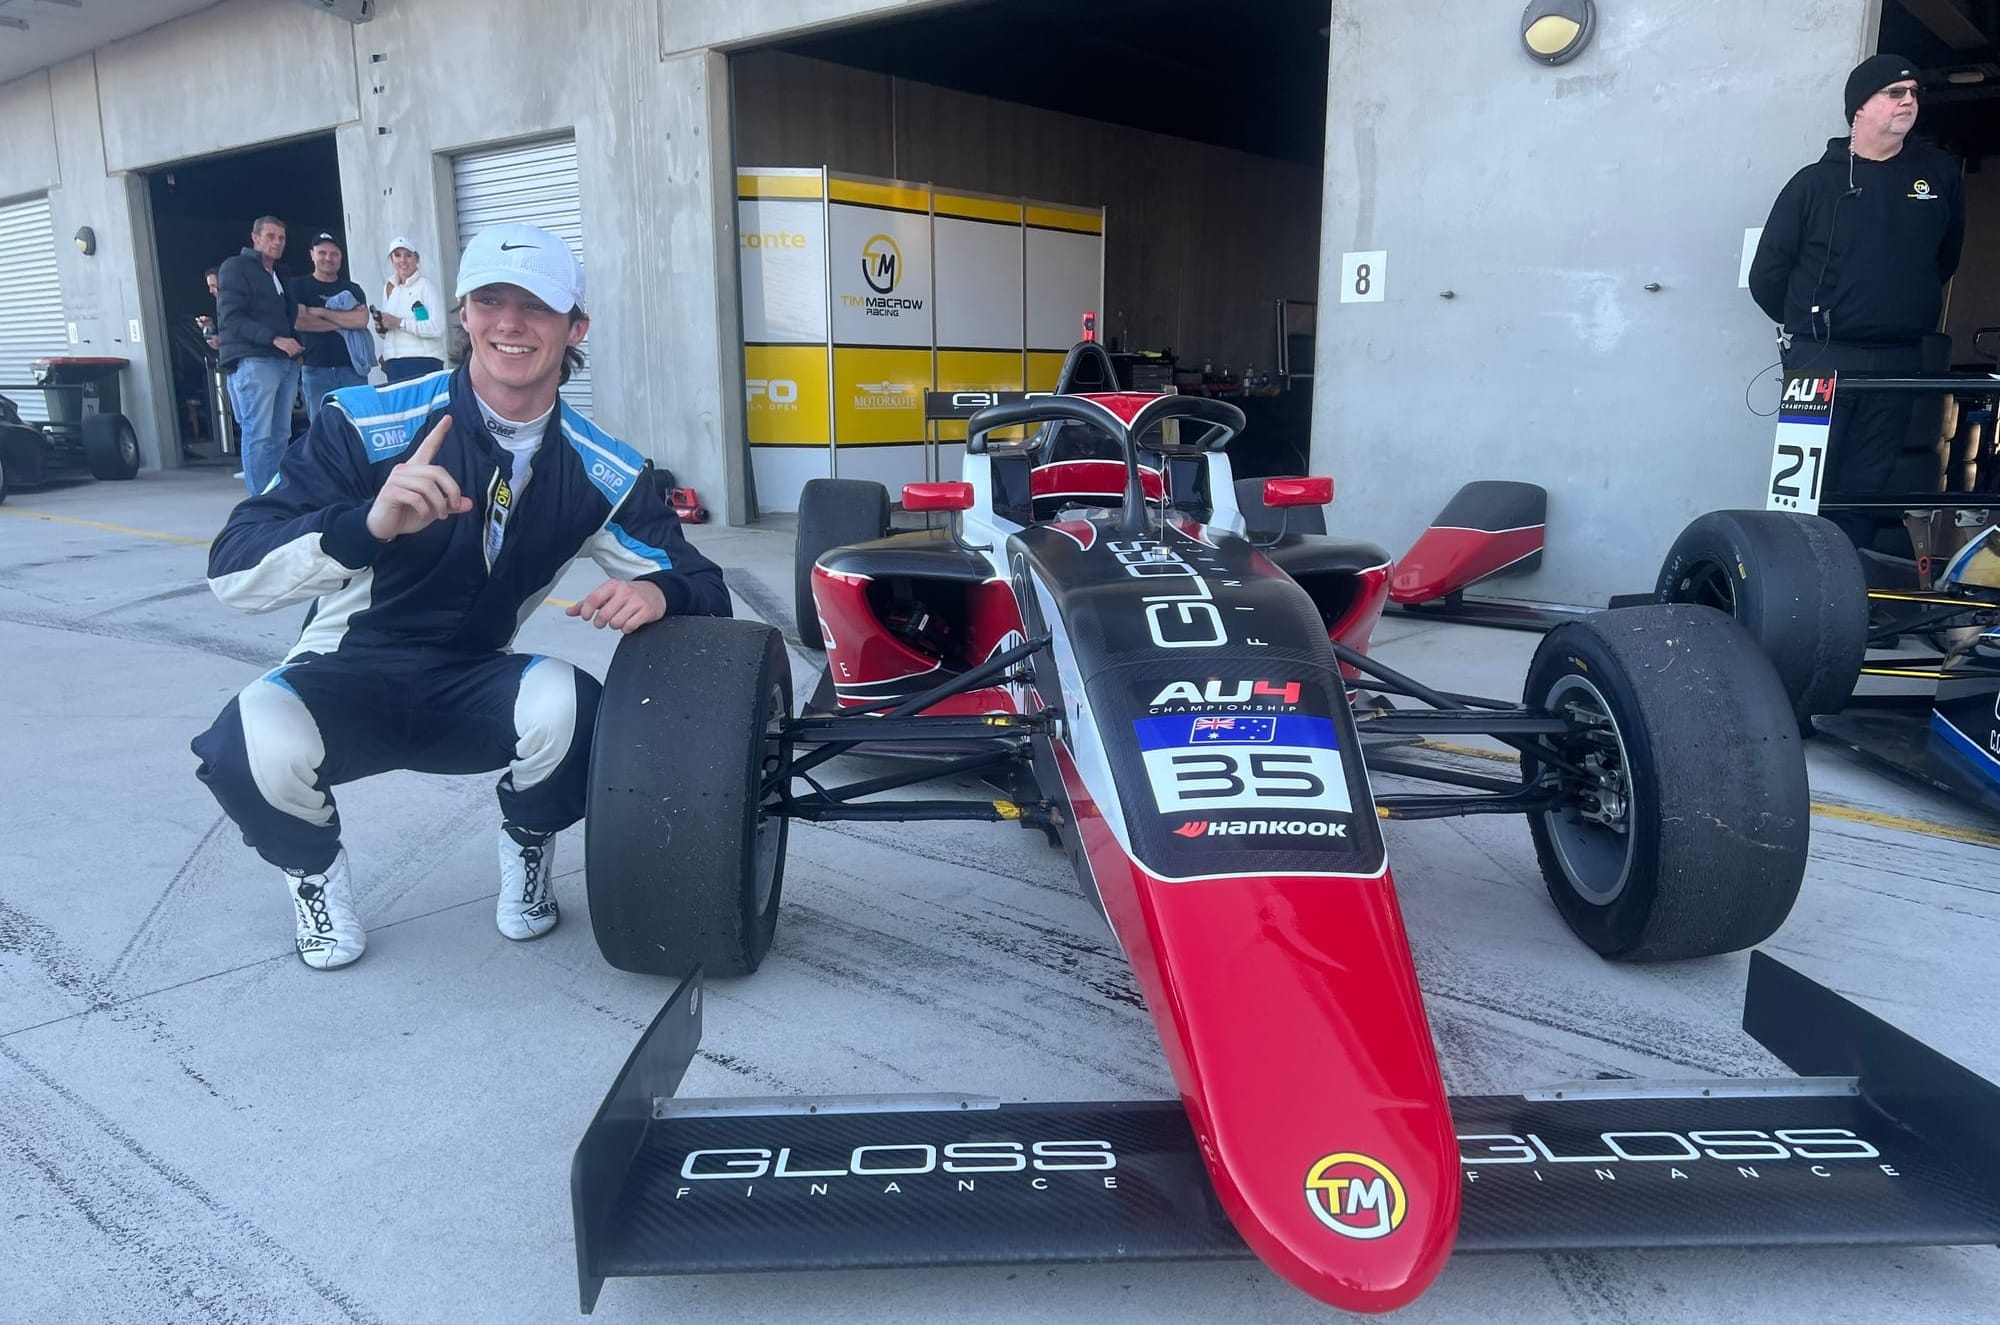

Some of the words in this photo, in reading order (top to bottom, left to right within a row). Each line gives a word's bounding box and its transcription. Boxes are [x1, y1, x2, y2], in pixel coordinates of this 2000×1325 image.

[1355, 263, 1371, 296] 8
[841, 295, 864, 307] TIM
[1783, 378, 1835, 402] AU4
[1781, 403, 1828, 411] CHAMPIONSHIP
[371, 429, 407, 448] OMP
[487, 419, 517, 436] OMP
[591, 463, 624, 488] OMP
[1771, 444, 1822, 500] 21
[1150, 680, 1301, 706] AU4
[1149, 704, 1298, 714] CHAMPIONSHIP
[1172, 753, 1325, 800] 35
[1456, 1129, 1880, 1164] GLOSS
[680, 1140, 1117, 1180] GLOSS
[1466, 1164, 1900, 1183] FINANCE
[676, 1176, 1118, 1200] FINANCE
